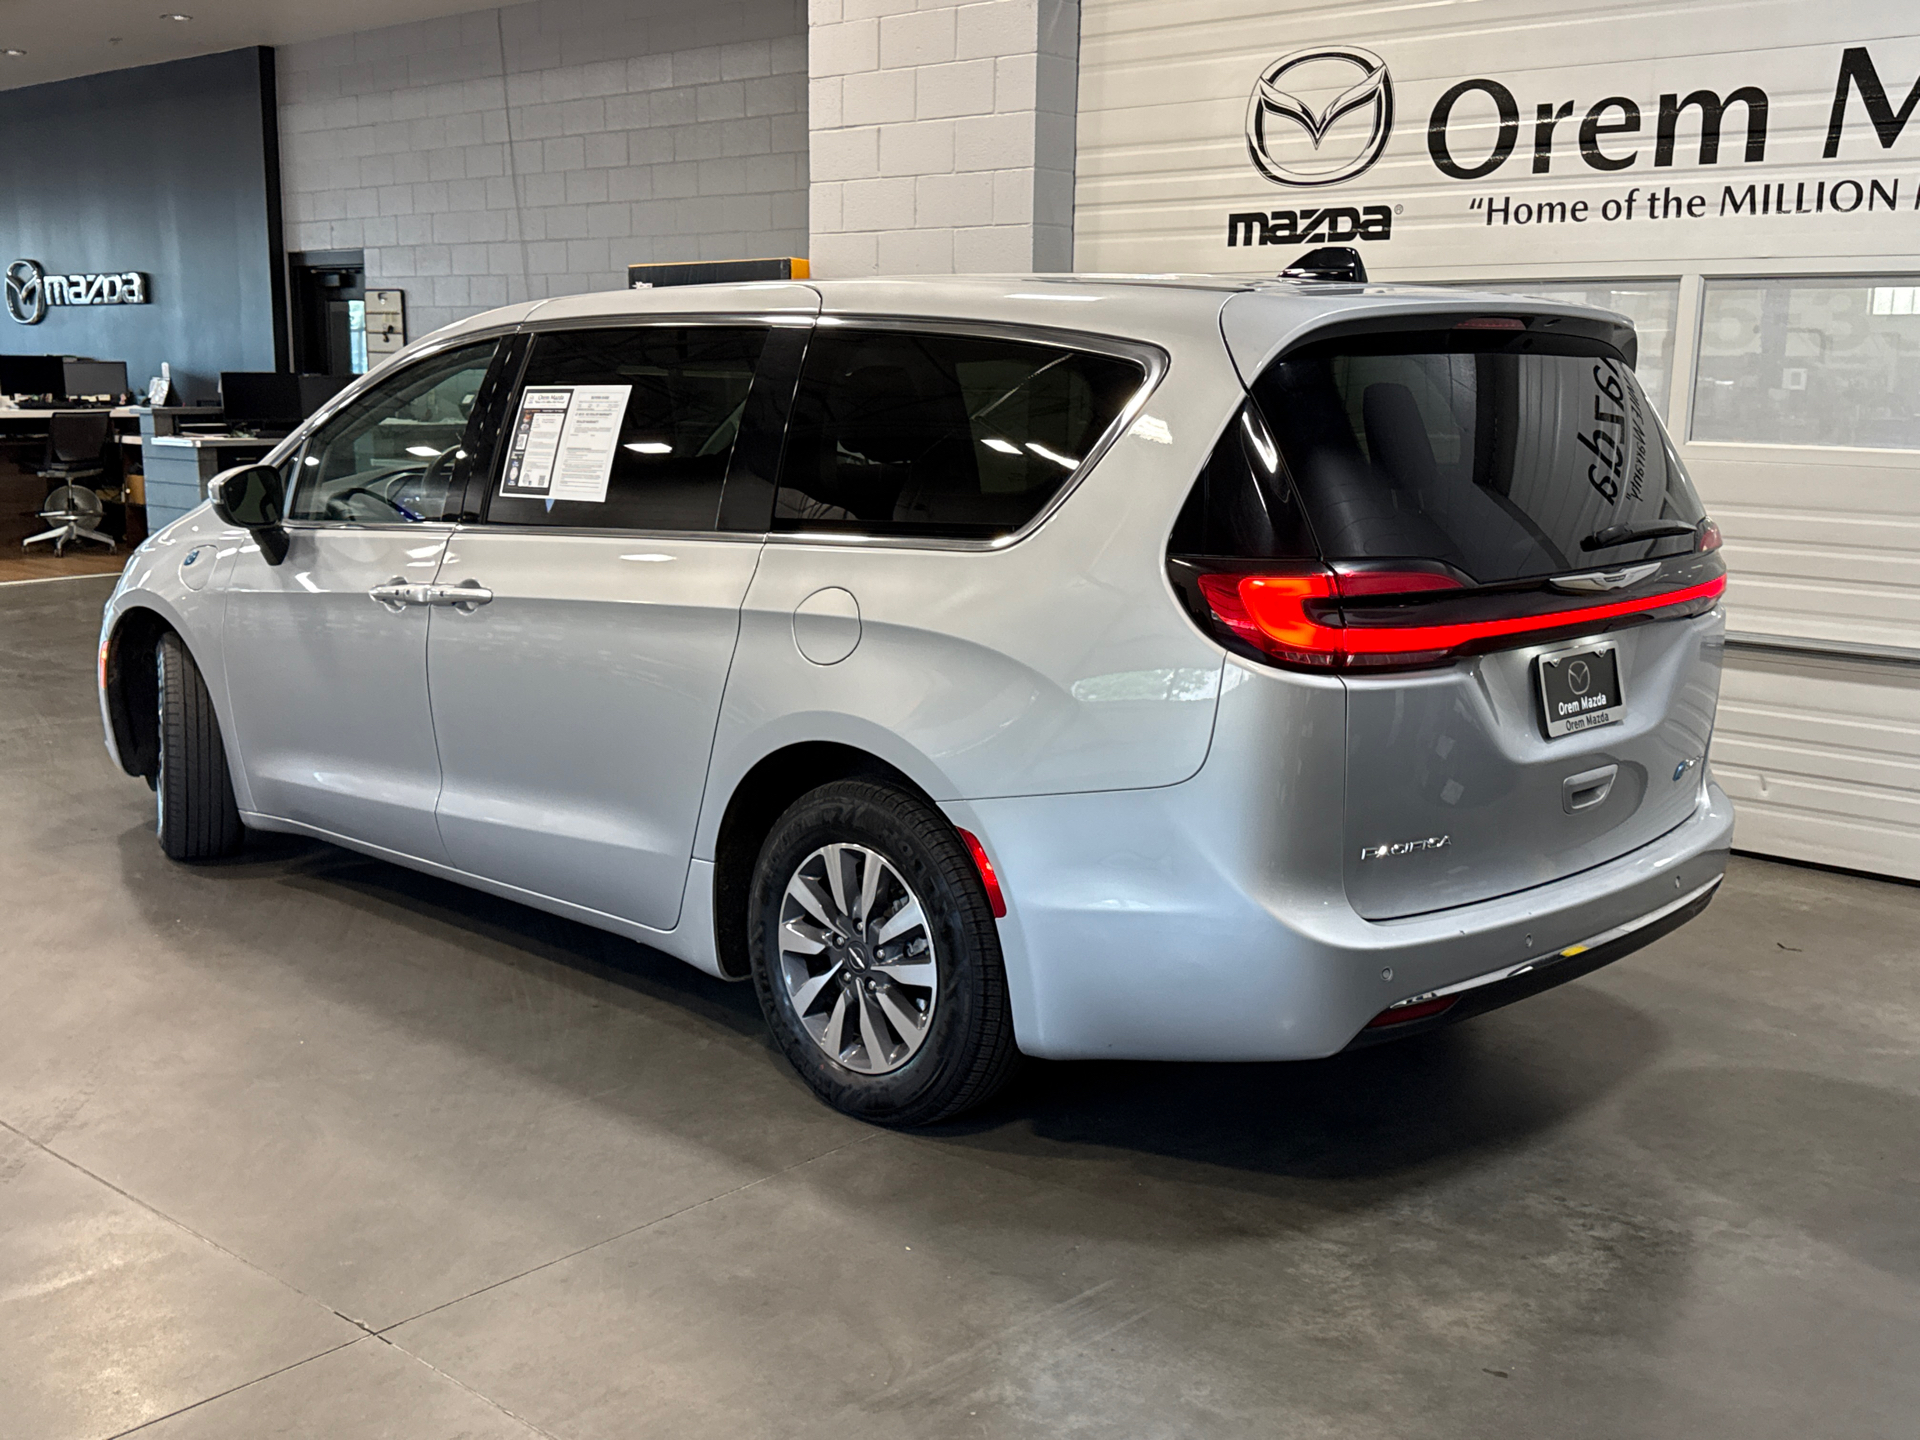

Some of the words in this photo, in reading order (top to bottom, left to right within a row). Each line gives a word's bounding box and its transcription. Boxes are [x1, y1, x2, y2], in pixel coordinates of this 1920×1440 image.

[1427, 78, 1769, 180] Orem
[1601, 189, 1640, 221] of
[1647, 187, 1706, 220] the
[1719, 179, 1899, 216] MILLION
[1558, 701, 1580, 716] Orem
[1580, 692, 1607, 710] Mazda
[1565, 719, 1586, 731] Orem
[1585, 712, 1610, 726] Mazda
